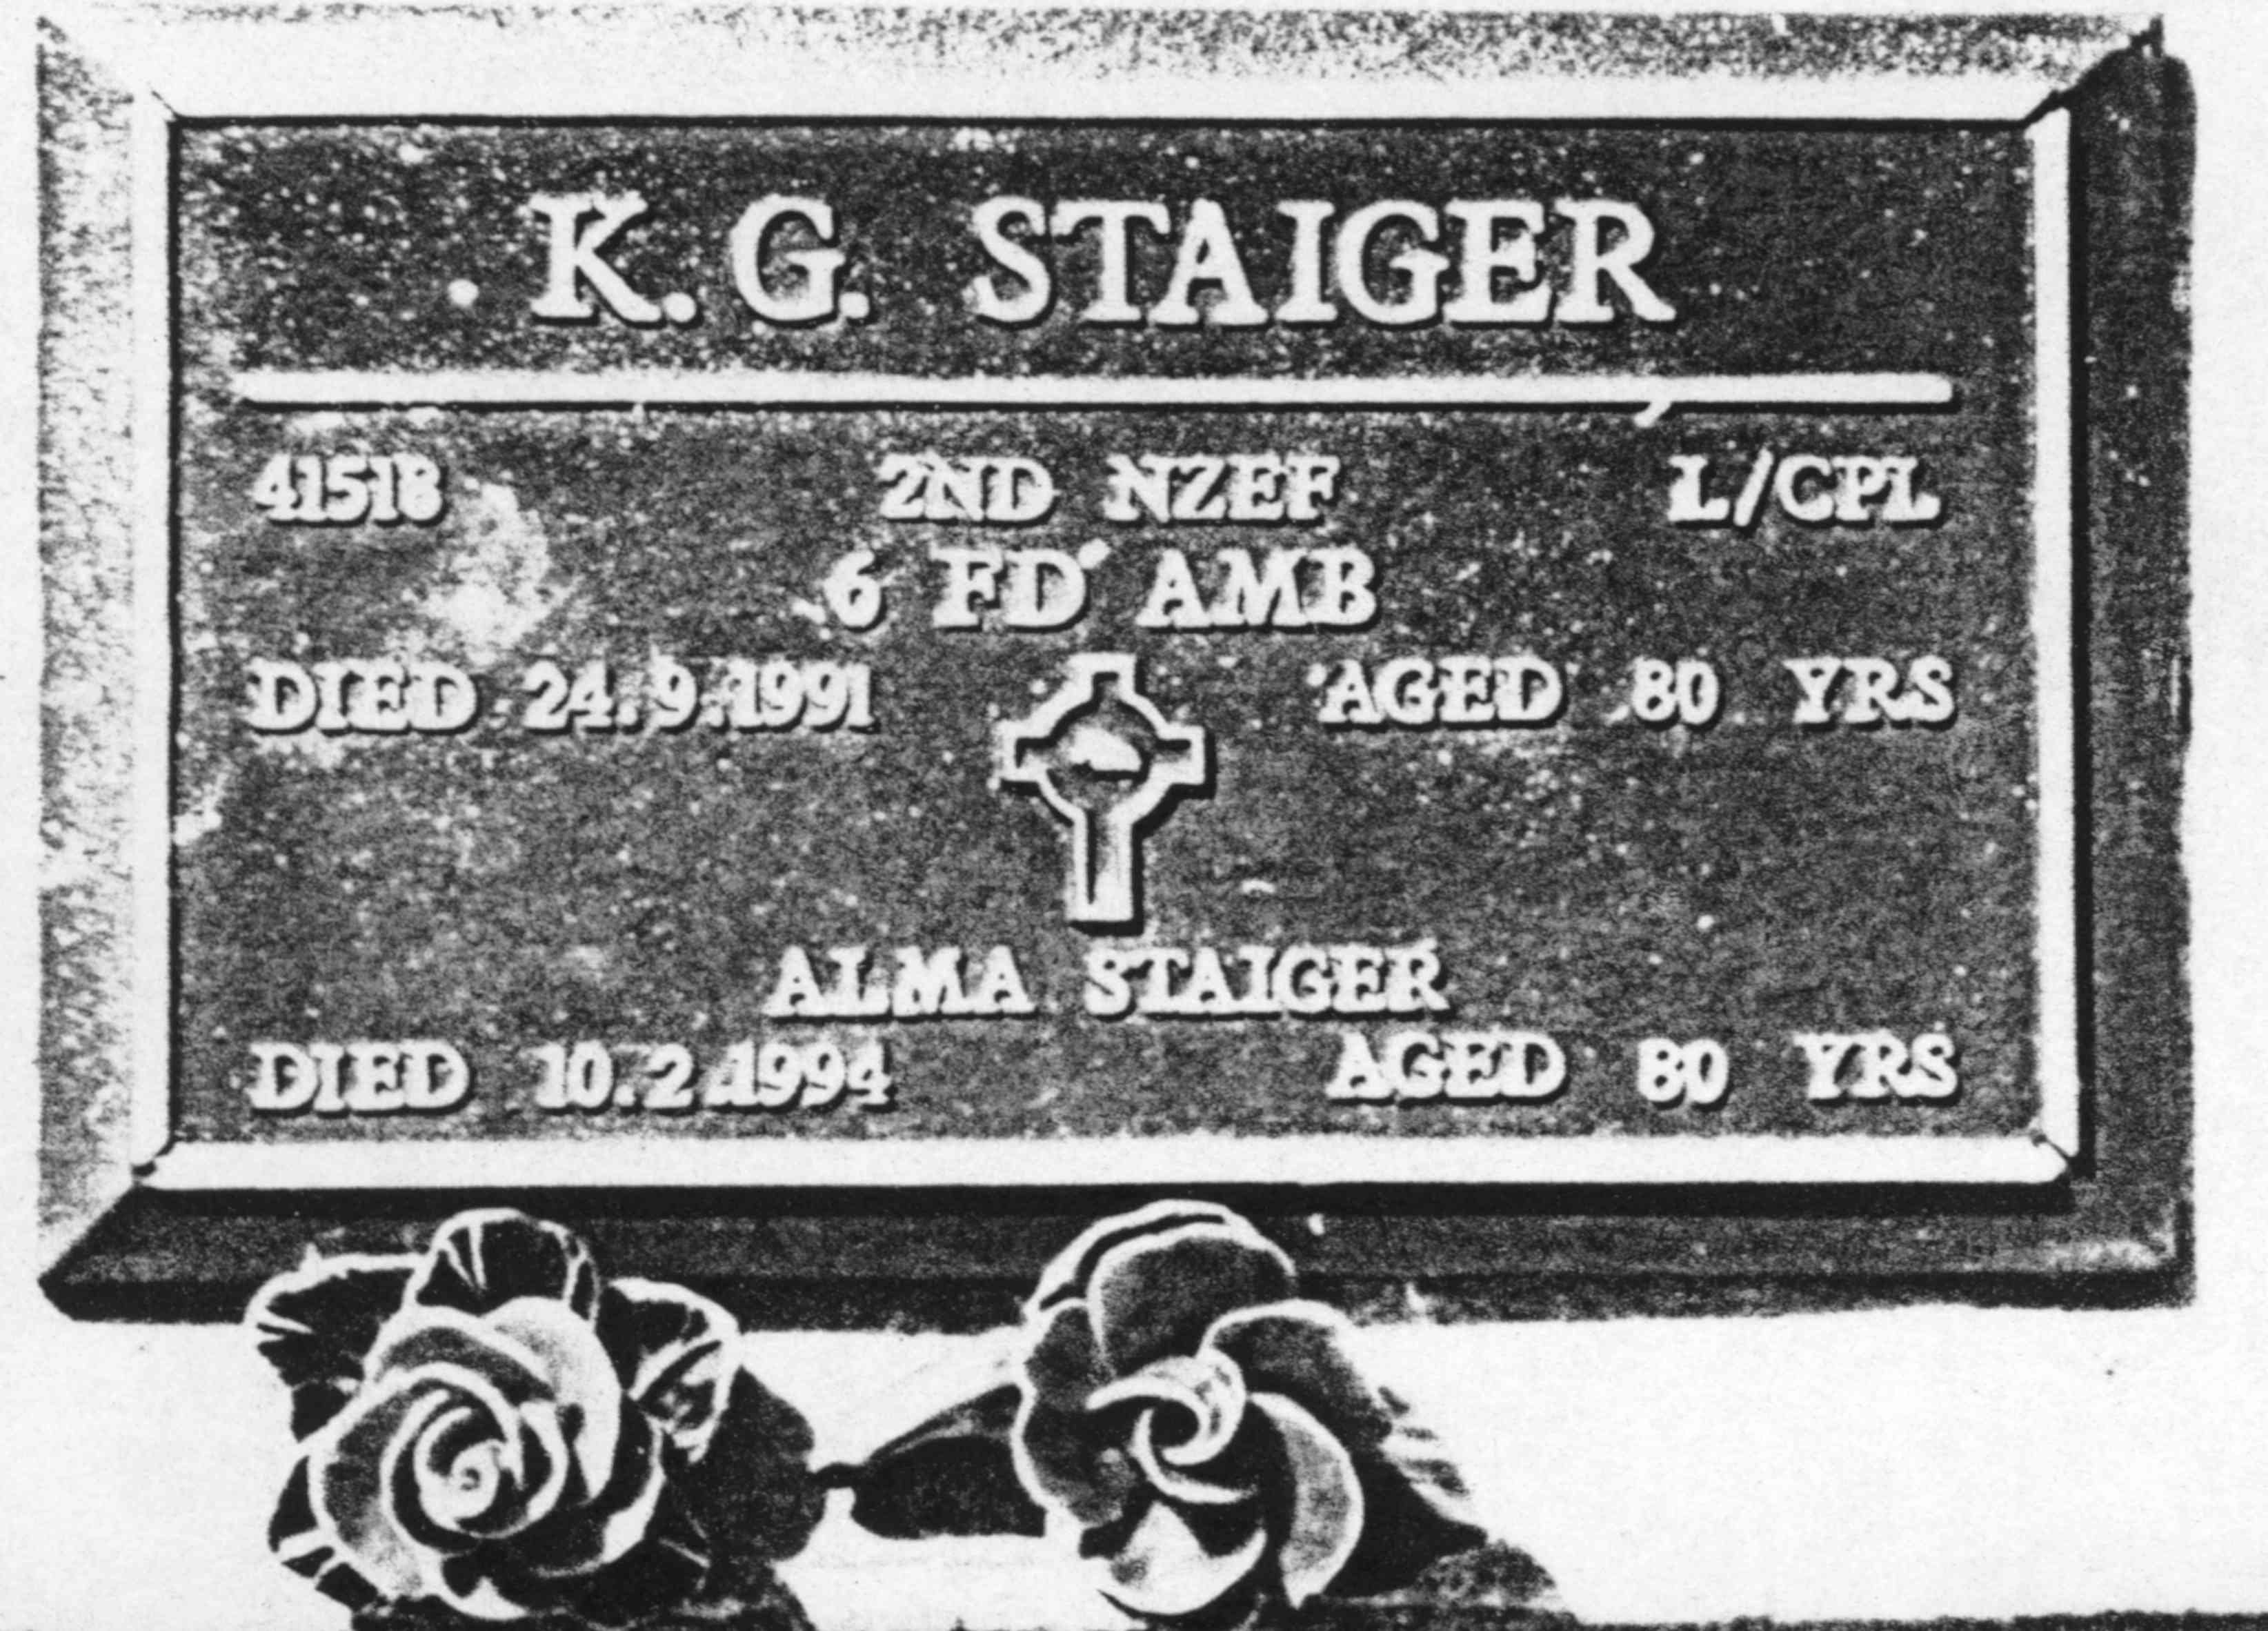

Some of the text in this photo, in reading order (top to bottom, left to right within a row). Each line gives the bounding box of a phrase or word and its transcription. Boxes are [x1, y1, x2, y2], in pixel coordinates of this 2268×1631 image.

[531, 194, 1678, 324] K. G. STAIGER
[251, 453, 441, 523] 41518
[878, 453, 1342, 522] 2ND NZEF
[1668, 450, 1940, 526] L/CPL
[824, 548, 1377, 628] 6 FD AMB
[248, 659, 477, 731] DIED
[1319, 657, 1954, 724] AGED 80 YRS
[764, 945, 1450, 1018] ALMA STAIGER
[245, 1040, 470, 1109] DIED
[1326, 1032, 1959, 1103] AGED 80 YRS
